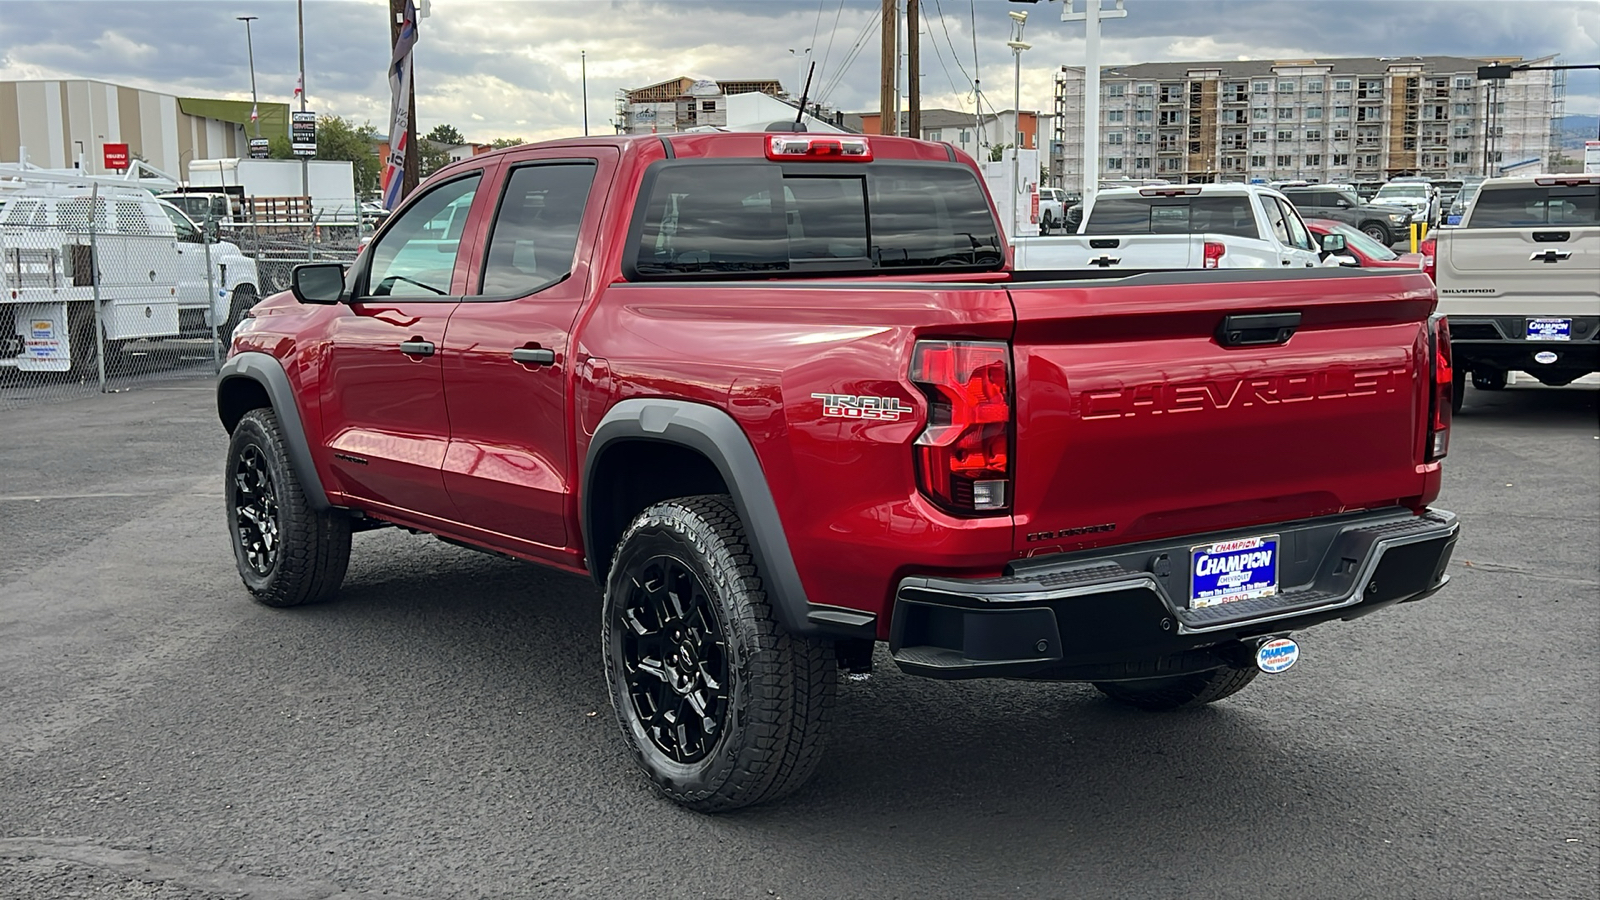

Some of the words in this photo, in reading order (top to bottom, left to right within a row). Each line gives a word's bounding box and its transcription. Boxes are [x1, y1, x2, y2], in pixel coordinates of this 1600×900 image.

[293, 113, 315, 121] Corwin
[1528, 322, 1568, 330] CHAMPION
[1081, 370, 1407, 420] CHEVROLET
[810, 392, 913, 413] TRAIL
[823, 406, 900, 421] BOSS
[1026, 523, 1116, 542] COLORADO
[1215, 539, 1257, 553] CHAMPION
[1195, 550, 1272, 577] CHAMPION
[1219, 573, 1250, 584] CHEVROLET
[1221, 593, 1249, 604] RENO
[1266, 656, 1291, 665] CHEVROLET
